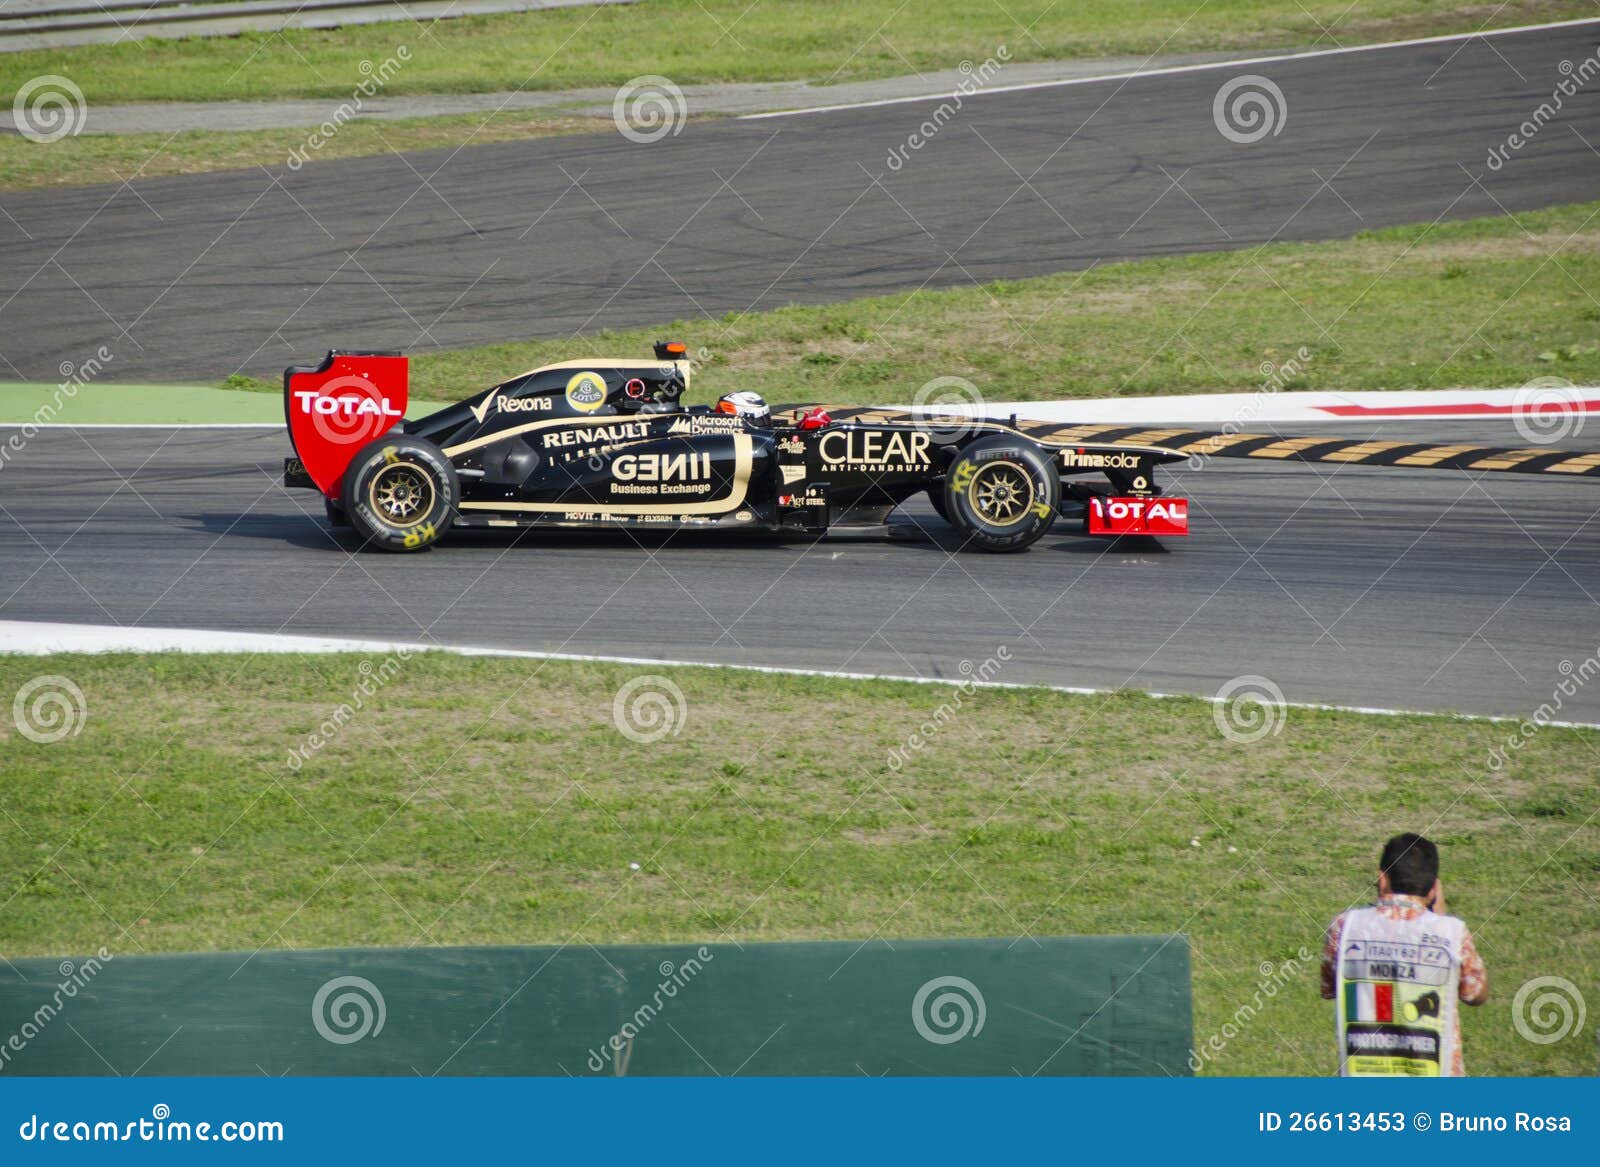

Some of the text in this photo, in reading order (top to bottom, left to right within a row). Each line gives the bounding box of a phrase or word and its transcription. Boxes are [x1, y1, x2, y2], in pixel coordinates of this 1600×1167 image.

[294, 391, 401, 416] TOTAL
[497, 394, 552, 413] Rexona
[571, 390, 602, 402] LOTUS
[691, 415, 744, 427] Microsoft
[543, 422, 651, 448] RENAULT
[691, 425, 744, 435] Dynamics
[819, 431, 931, 464] CLEAR
[611, 452, 711, 481] GENII
[1060, 448, 1141, 469] Trinasolar
[821, 464, 930, 472] ANTI-DANDRUFF
[610, 483, 658, 494] Business
[660, 483, 711, 494] Exchange
[1369, 963, 1416, 979] MONZA
